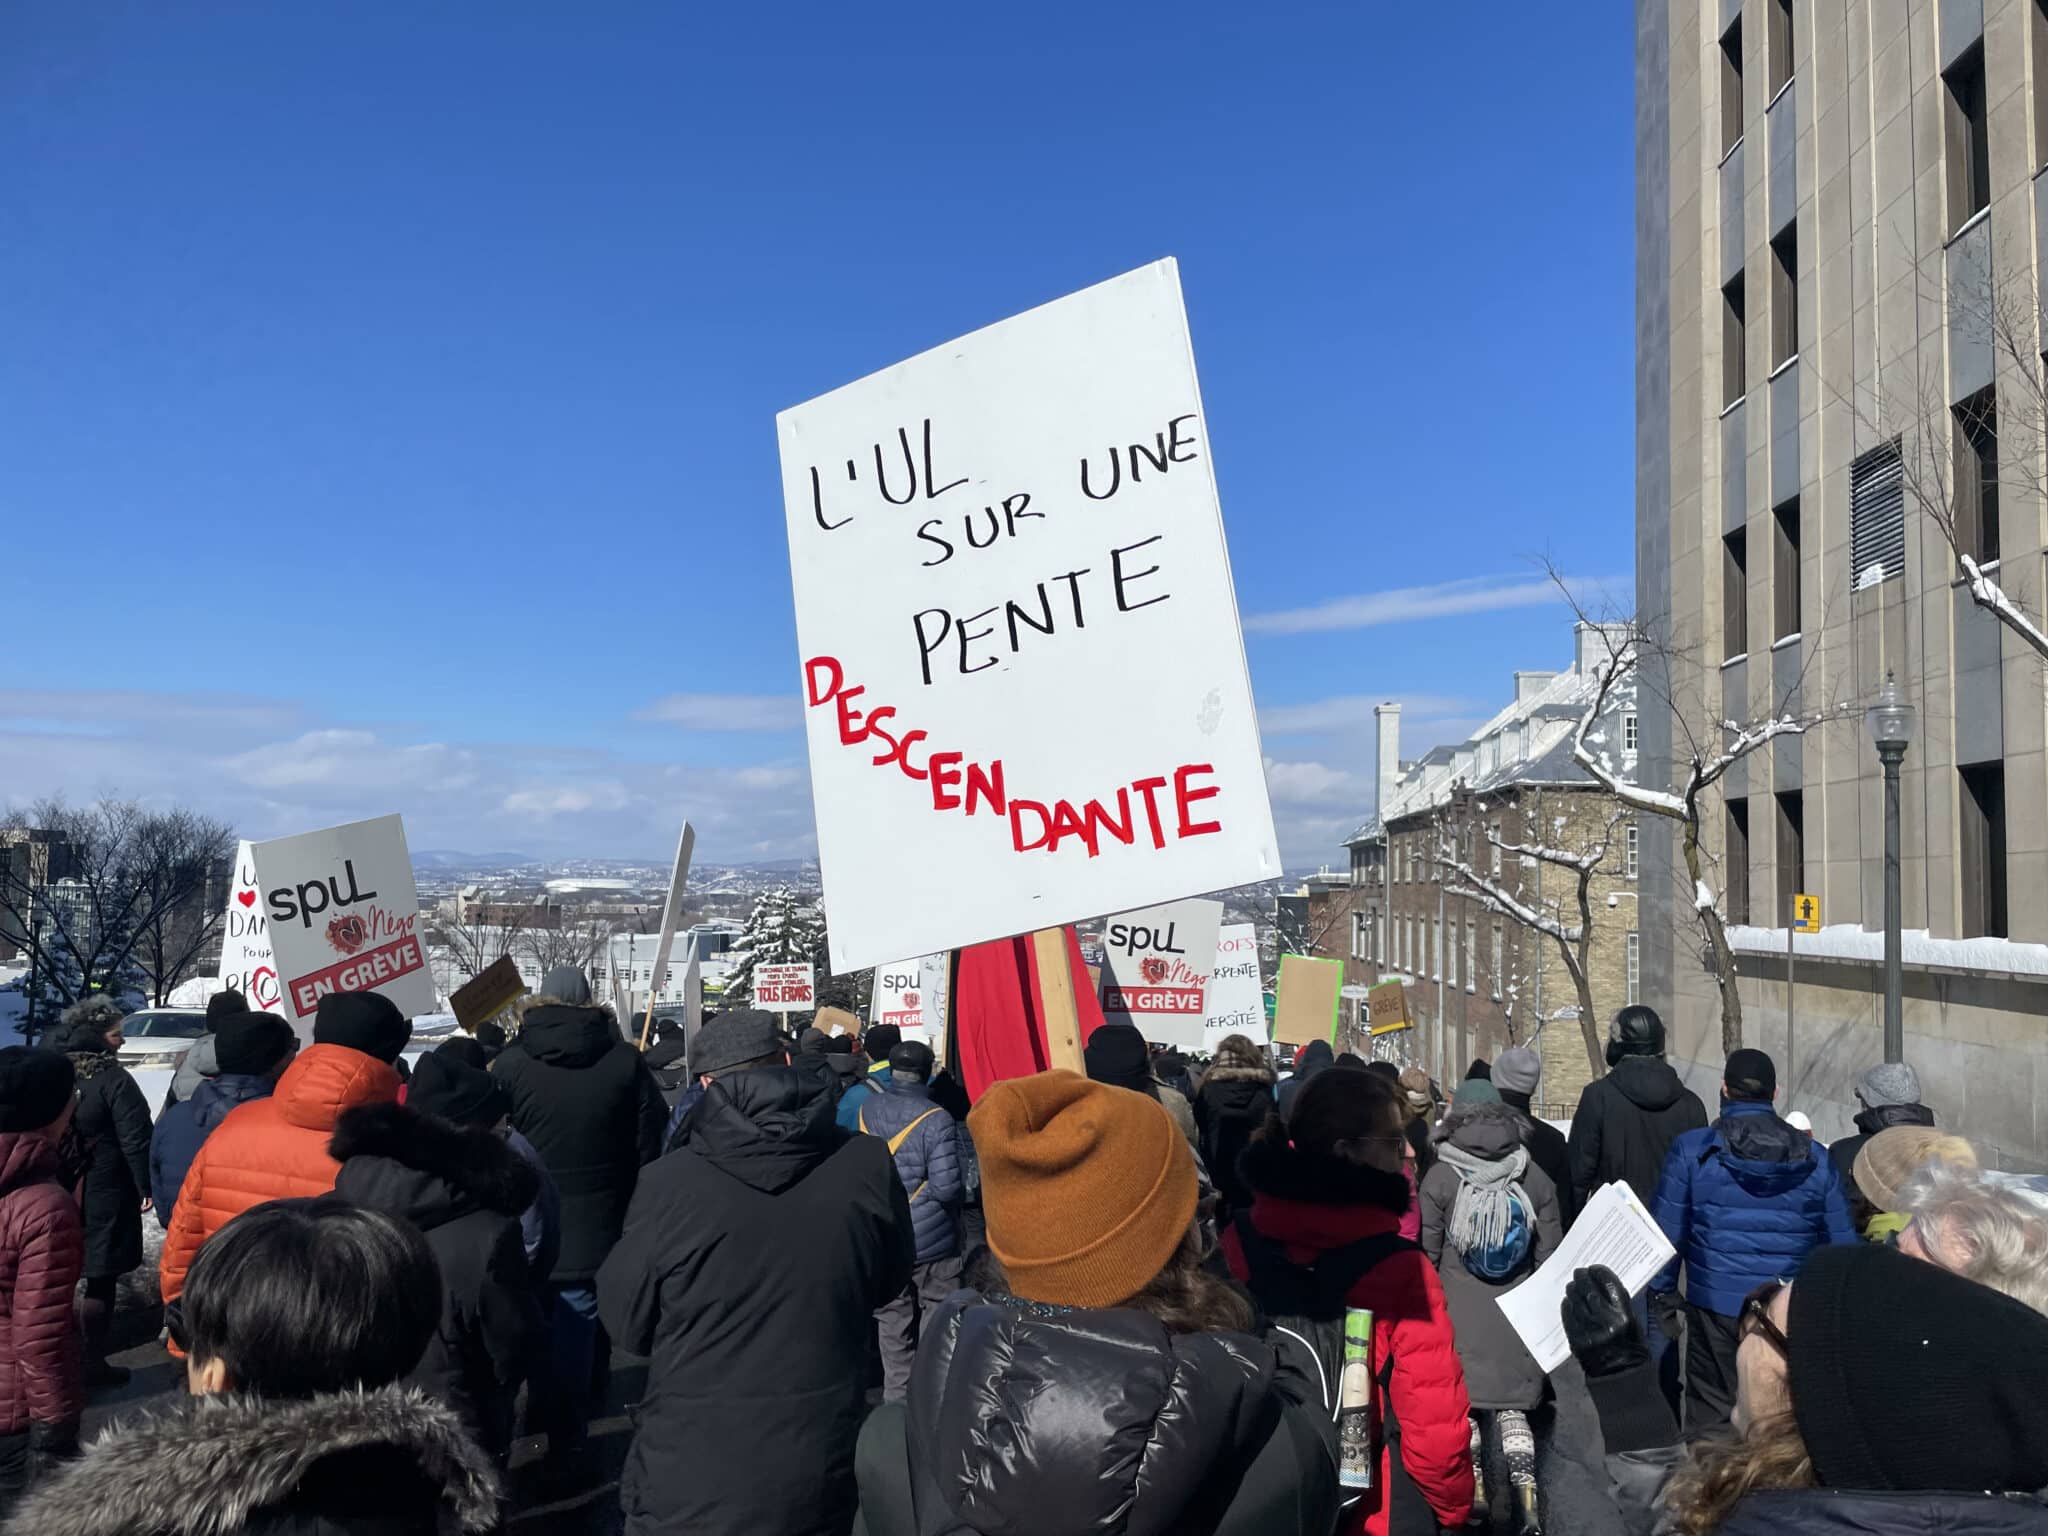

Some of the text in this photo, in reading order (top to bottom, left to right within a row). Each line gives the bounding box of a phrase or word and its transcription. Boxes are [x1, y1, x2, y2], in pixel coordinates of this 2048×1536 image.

[811, 418, 969, 530] L'UL
[917, 414, 1197, 566] SUR UNE
[913, 535, 1170, 685] PENTE
[805, 656, 1221, 858] DESCENDANTE
[368, 904, 416, 942] Négo
[297, 943, 418, 1010] EN GRÈVE
[756, 986, 780, 1002] TOUS
[1108, 990, 1200, 1010] EN GRÈVE
[1167, 958, 1209, 990] Négo
